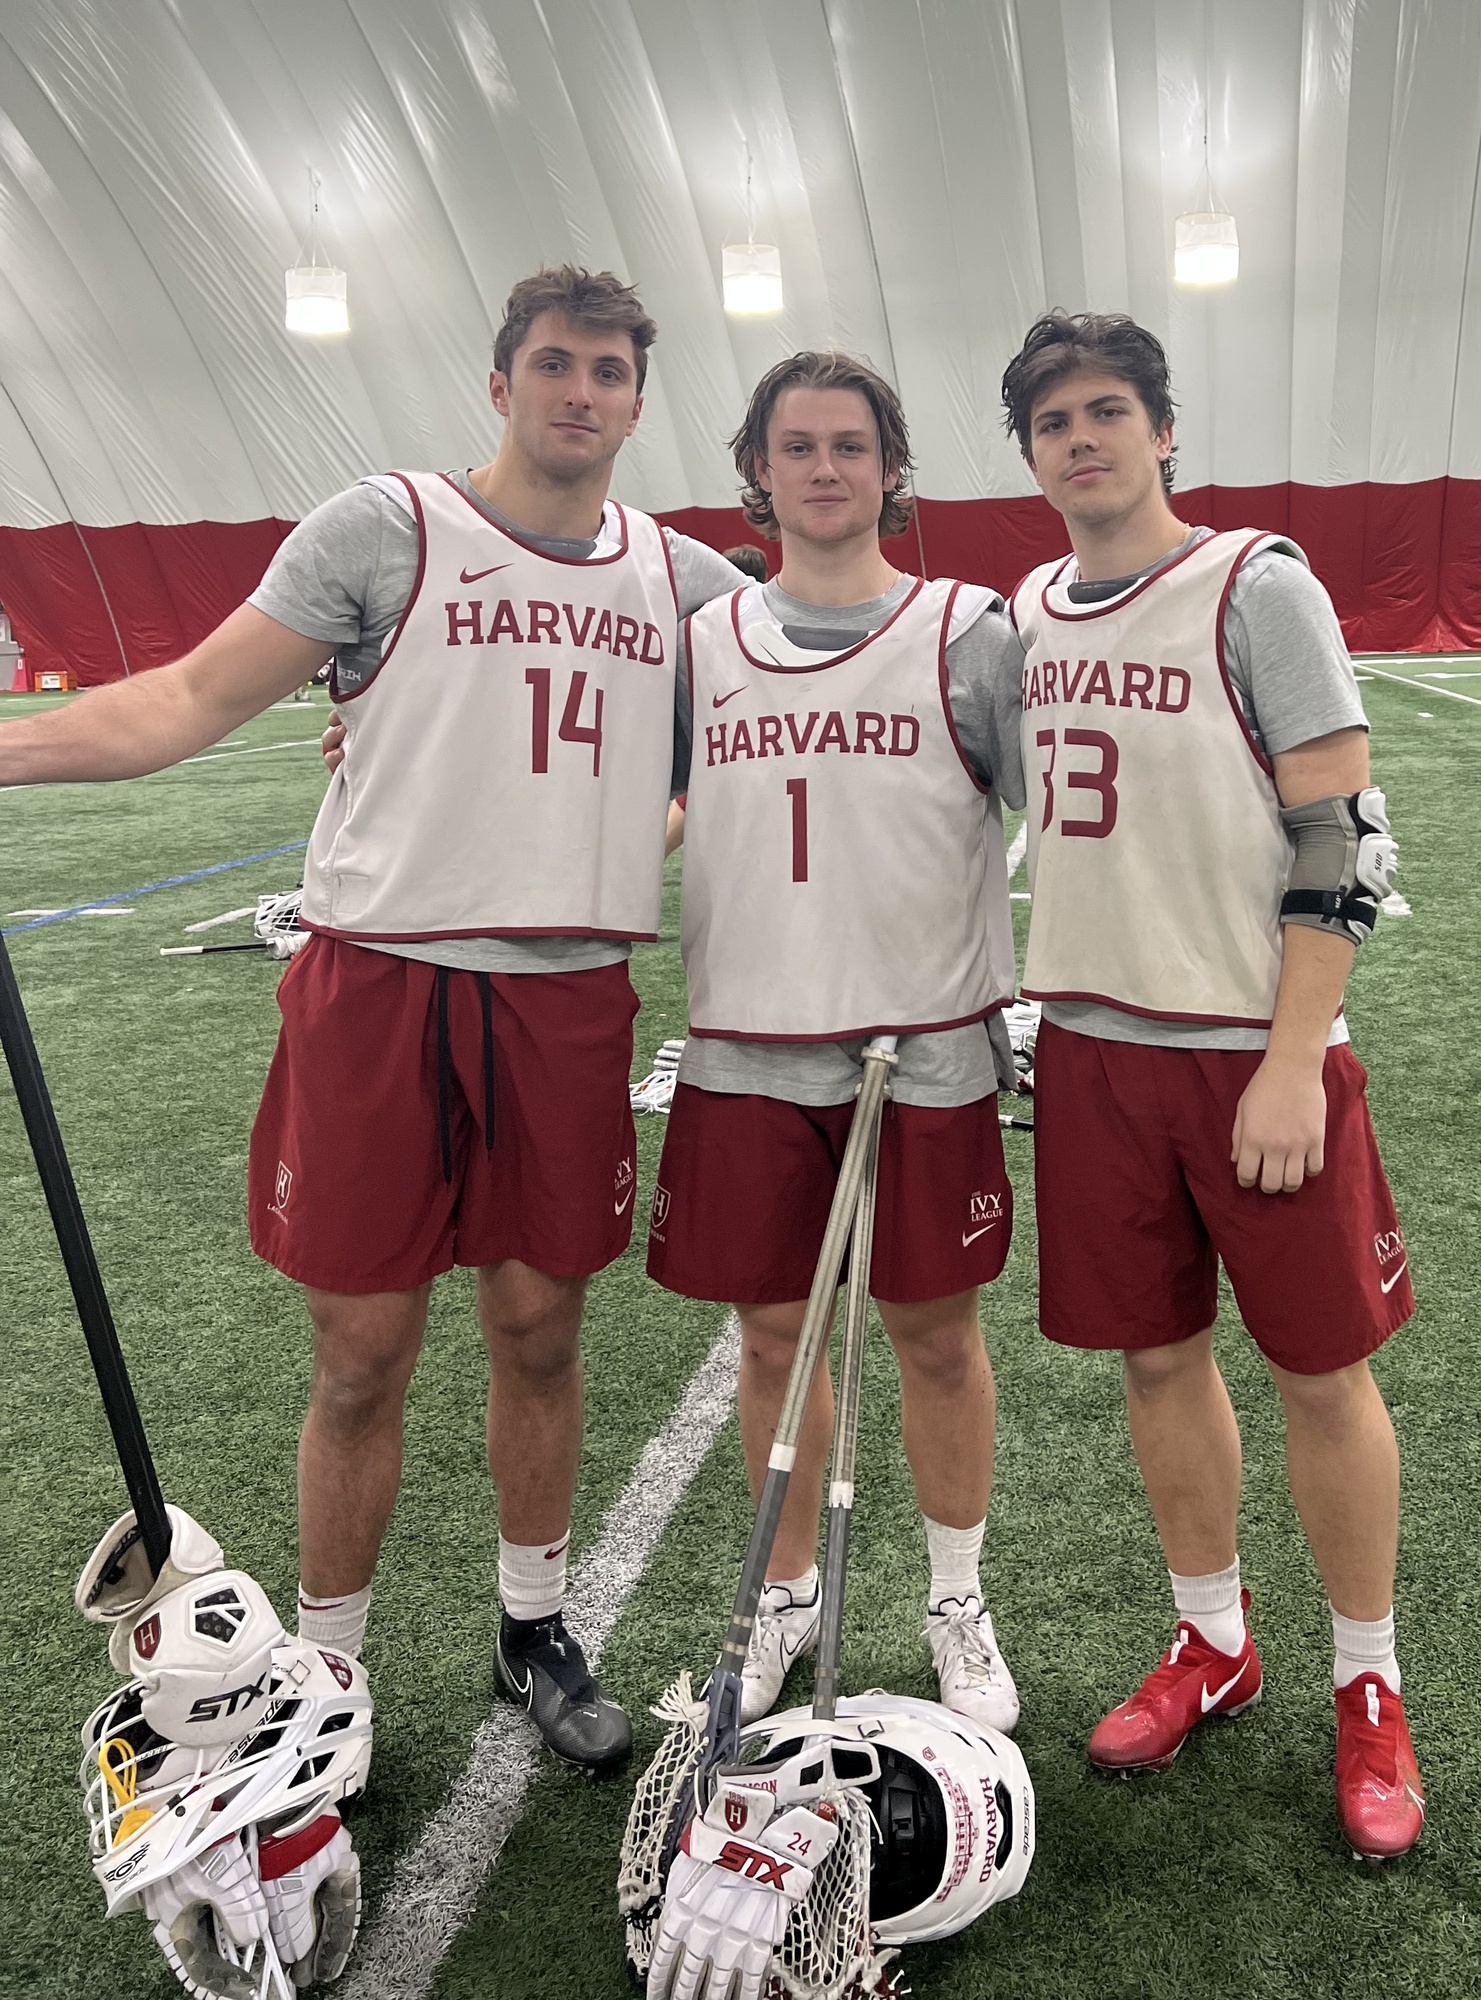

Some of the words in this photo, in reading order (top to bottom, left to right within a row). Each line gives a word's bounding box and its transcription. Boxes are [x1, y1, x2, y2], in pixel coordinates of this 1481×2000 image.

[445, 599, 665, 666] HARVARD
[525, 668, 604, 777] 14
[705, 711, 921, 767] HARVARD
[786, 778, 808, 883] 1
[970, 1193, 1002, 1214] IVY
[971, 1208, 1004, 1222] LEAGUE
[1374, 1226, 1400, 1258] IVY
[140, 1622, 156, 1651] H
[185, 1671, 267, 1724] STX
[729, 1804, 742, 1825] H
[819, 1802, 834, 1815] STX
[979, 1776, 998, 1883] HARVARD
[787, 1832, 812, 1857] 24
[712, 1840, 795, 1892] STX
